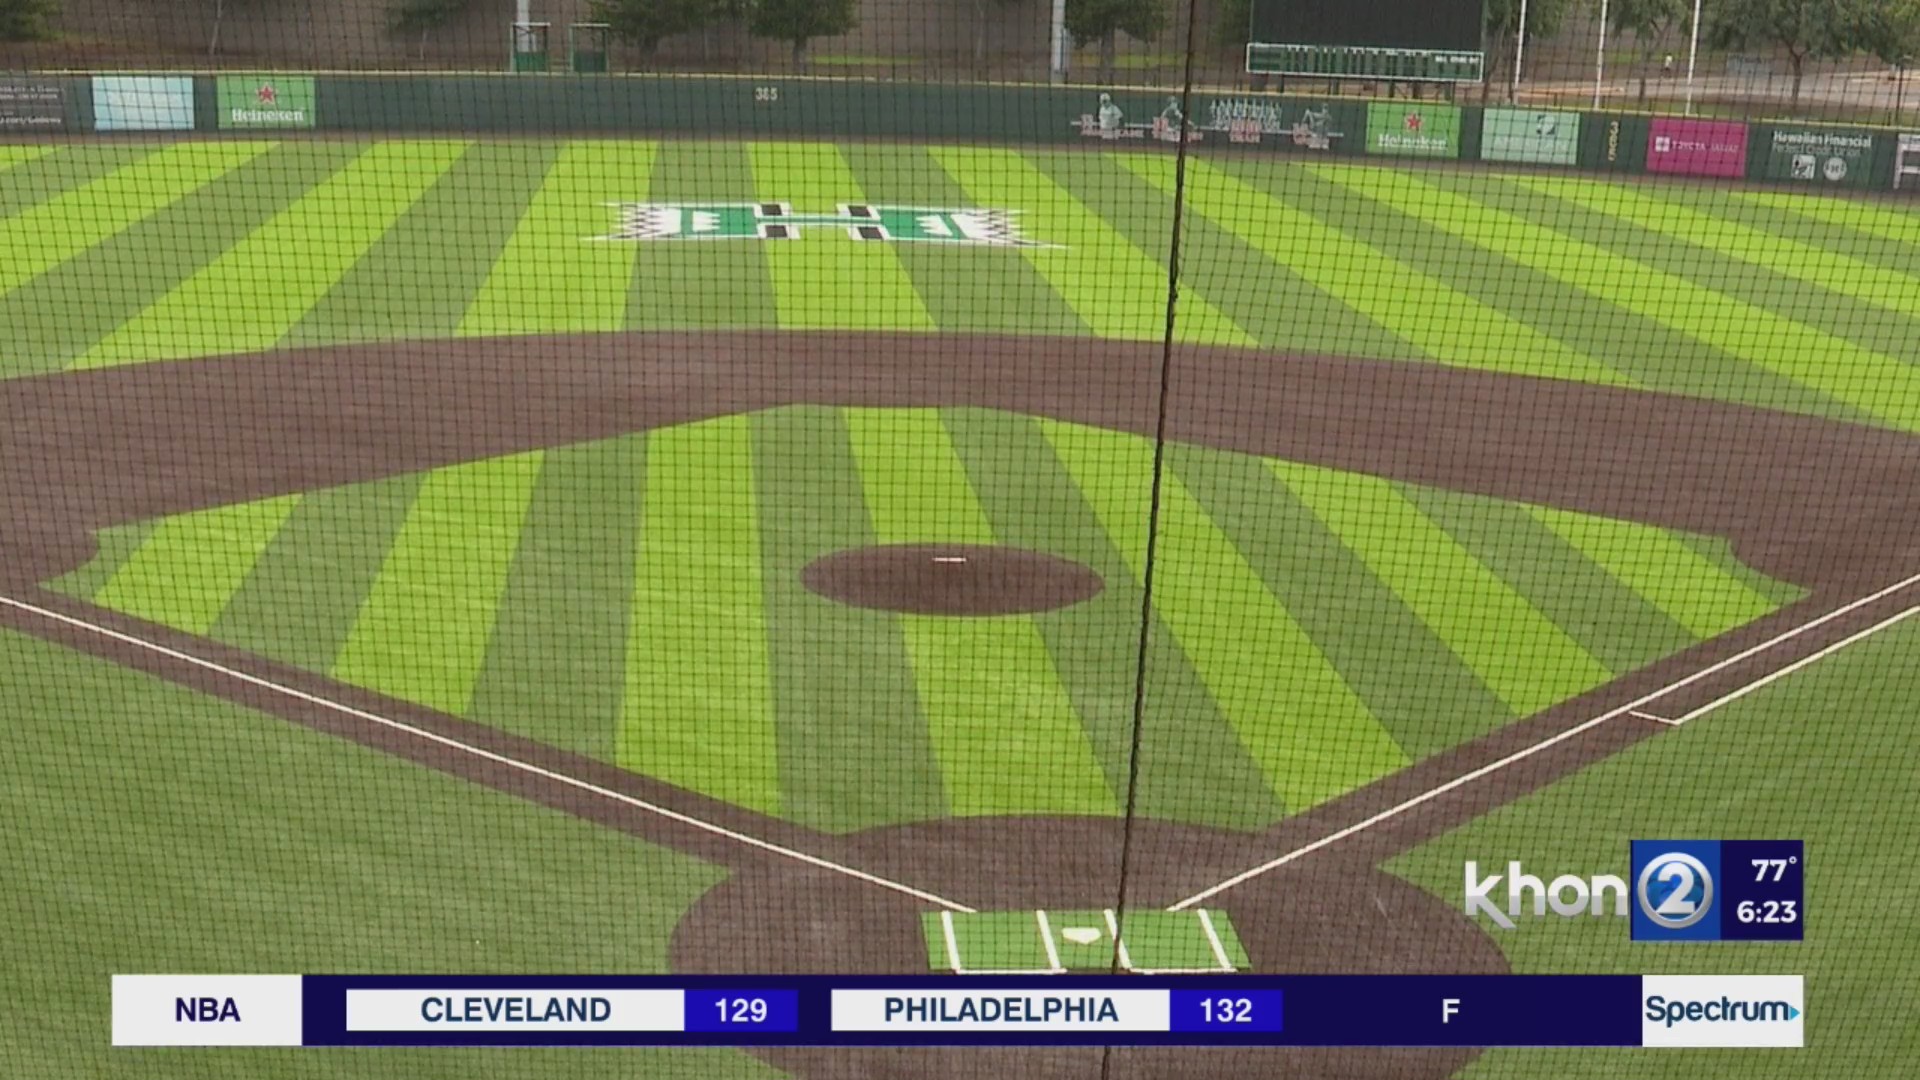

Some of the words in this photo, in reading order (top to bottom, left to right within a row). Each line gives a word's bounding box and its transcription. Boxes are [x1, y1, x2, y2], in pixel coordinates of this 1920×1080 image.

[231, 108, 304, 123] Heineken
[1378, 133, 1448, 150] Heineken
[1773, 130, 1823, 145] Hawaiian
[1824, 133, 1872, 148] Financial
